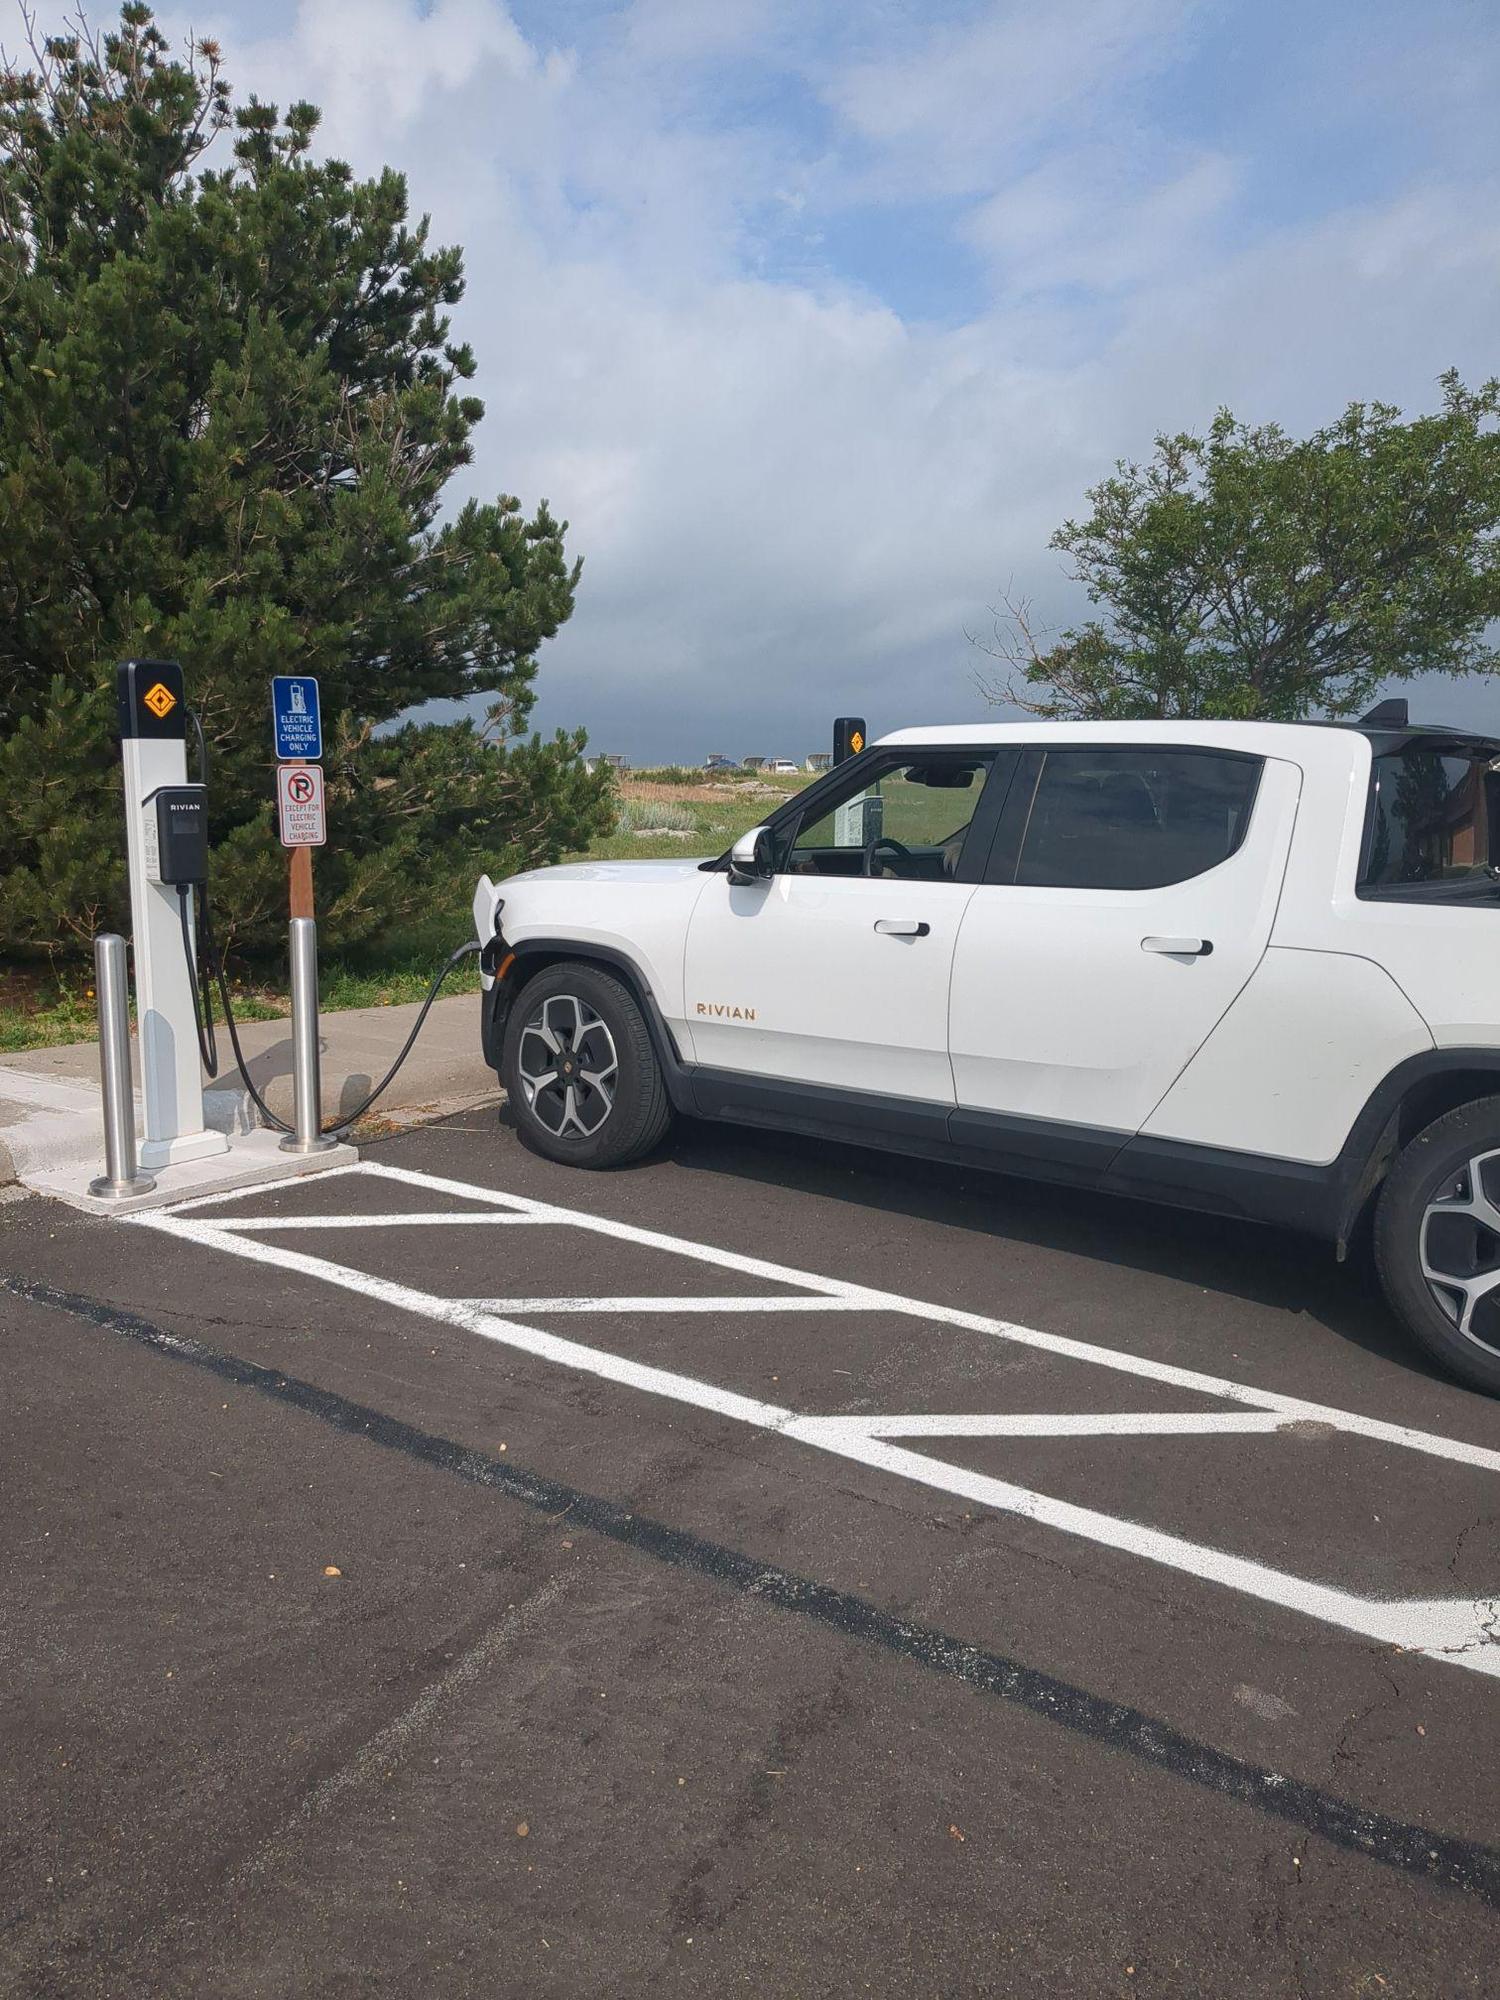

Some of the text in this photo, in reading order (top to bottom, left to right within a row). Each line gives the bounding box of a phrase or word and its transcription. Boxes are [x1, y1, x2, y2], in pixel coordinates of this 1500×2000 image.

[281, 715, 314, 723] ELECTRIC
[283, 724, 313, 732] VEHICLE
[289, 743, 309, 751] ONLY
[285, 804, 320, 812] EXCEPT FOR
[290, 823, 316, 831] VEHICLE
[289, 832, 319, 840] CHARGING
[696, 1003, 755, 1020] RIVIAN
